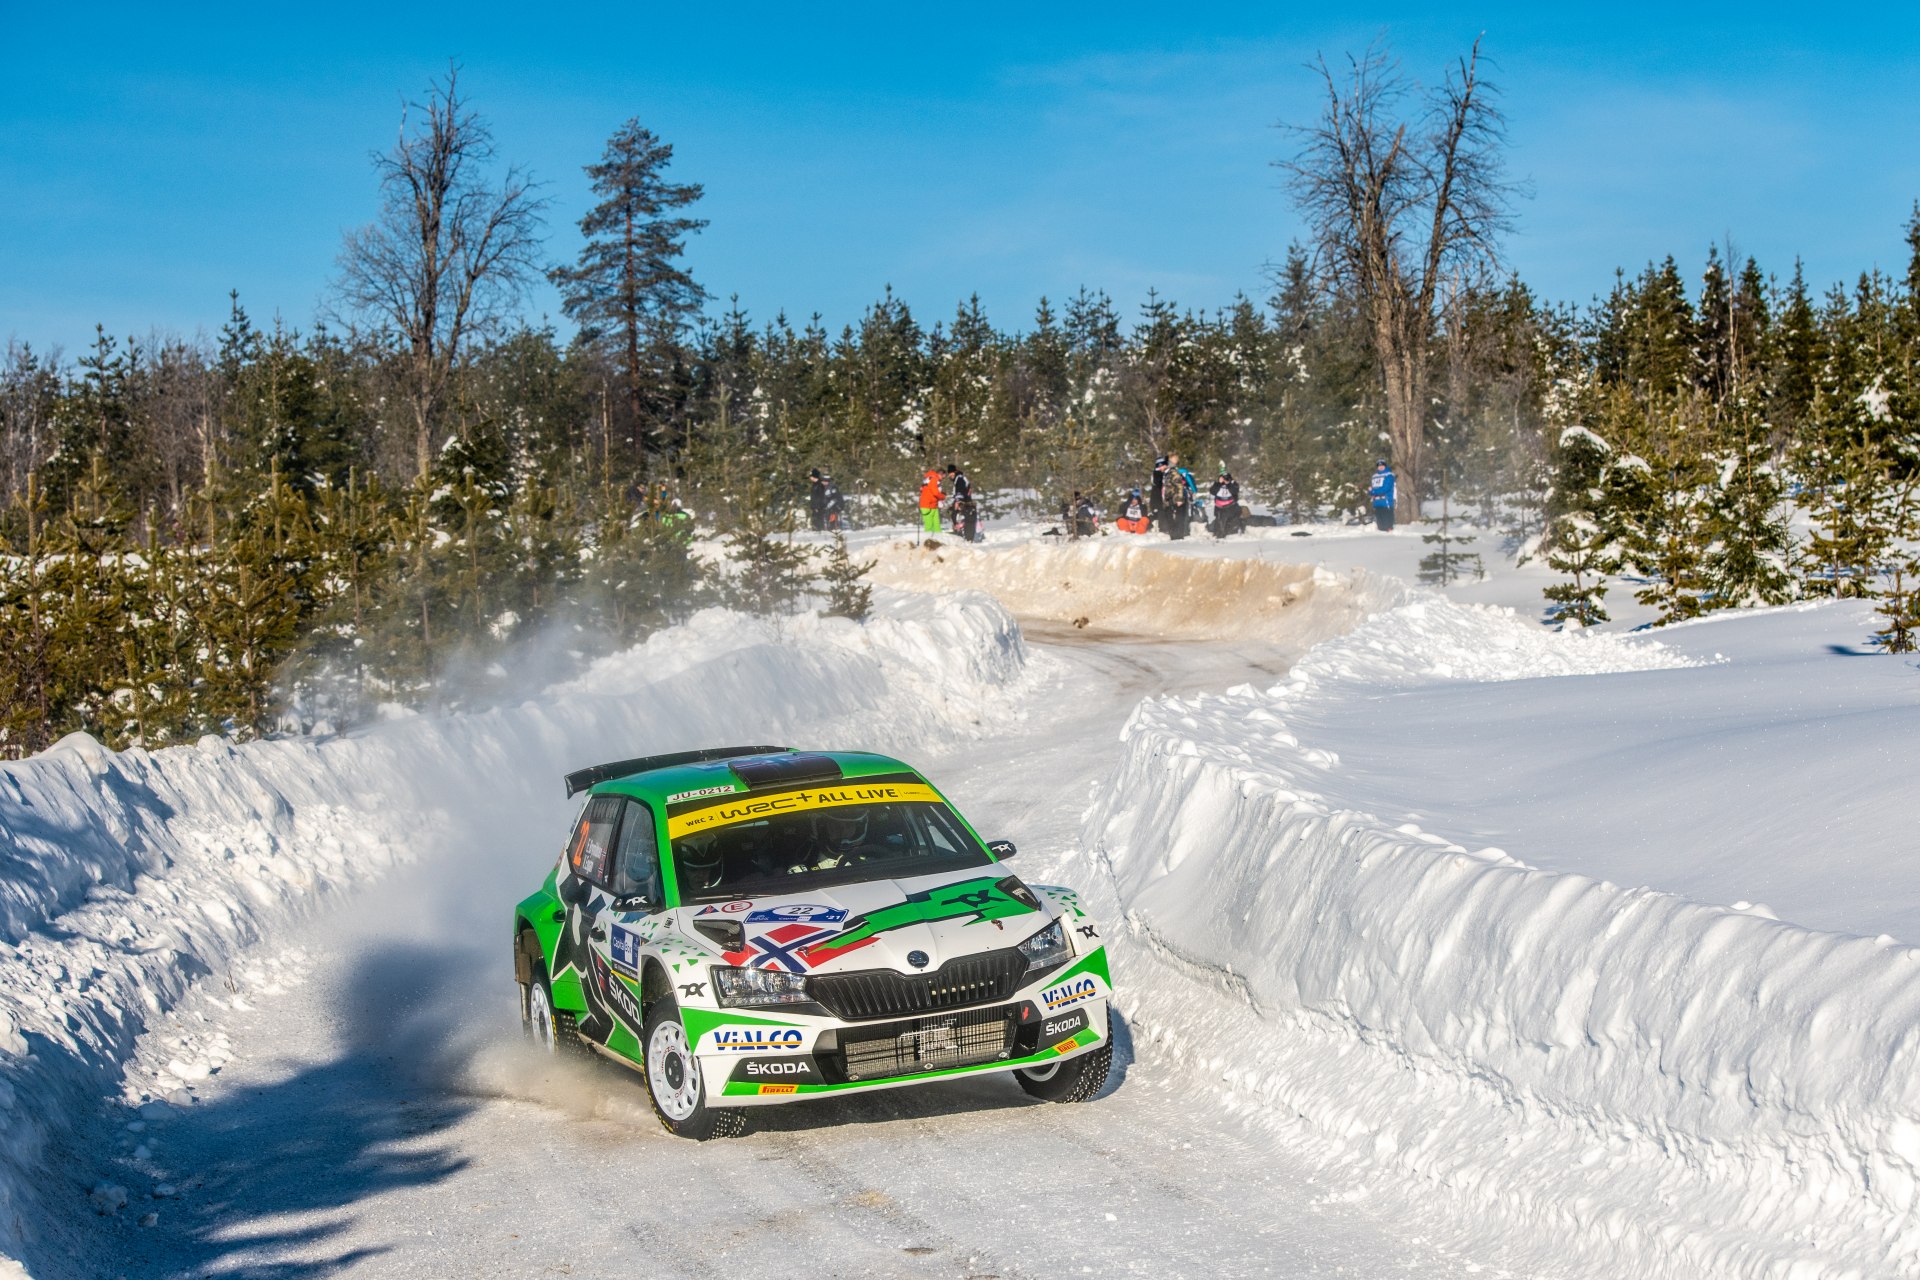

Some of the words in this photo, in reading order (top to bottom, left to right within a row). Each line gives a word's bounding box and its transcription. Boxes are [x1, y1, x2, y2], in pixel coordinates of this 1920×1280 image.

[672, 786, 732, 801] JU-0212
[685, 818, 706, 827] WRC
[818, 791, 853, 803] ALL
[856, 788, 898, 799] LIVE
[788, 907, 813, 915] 22
[609, 973, 644, 1029] ŠKOD
[1046, 1016, 1081, 1036] ŠKODA
[746, 1061, 811, 1075] ŠKODA
[762, 1085, 795, 1093] PIRELLI
